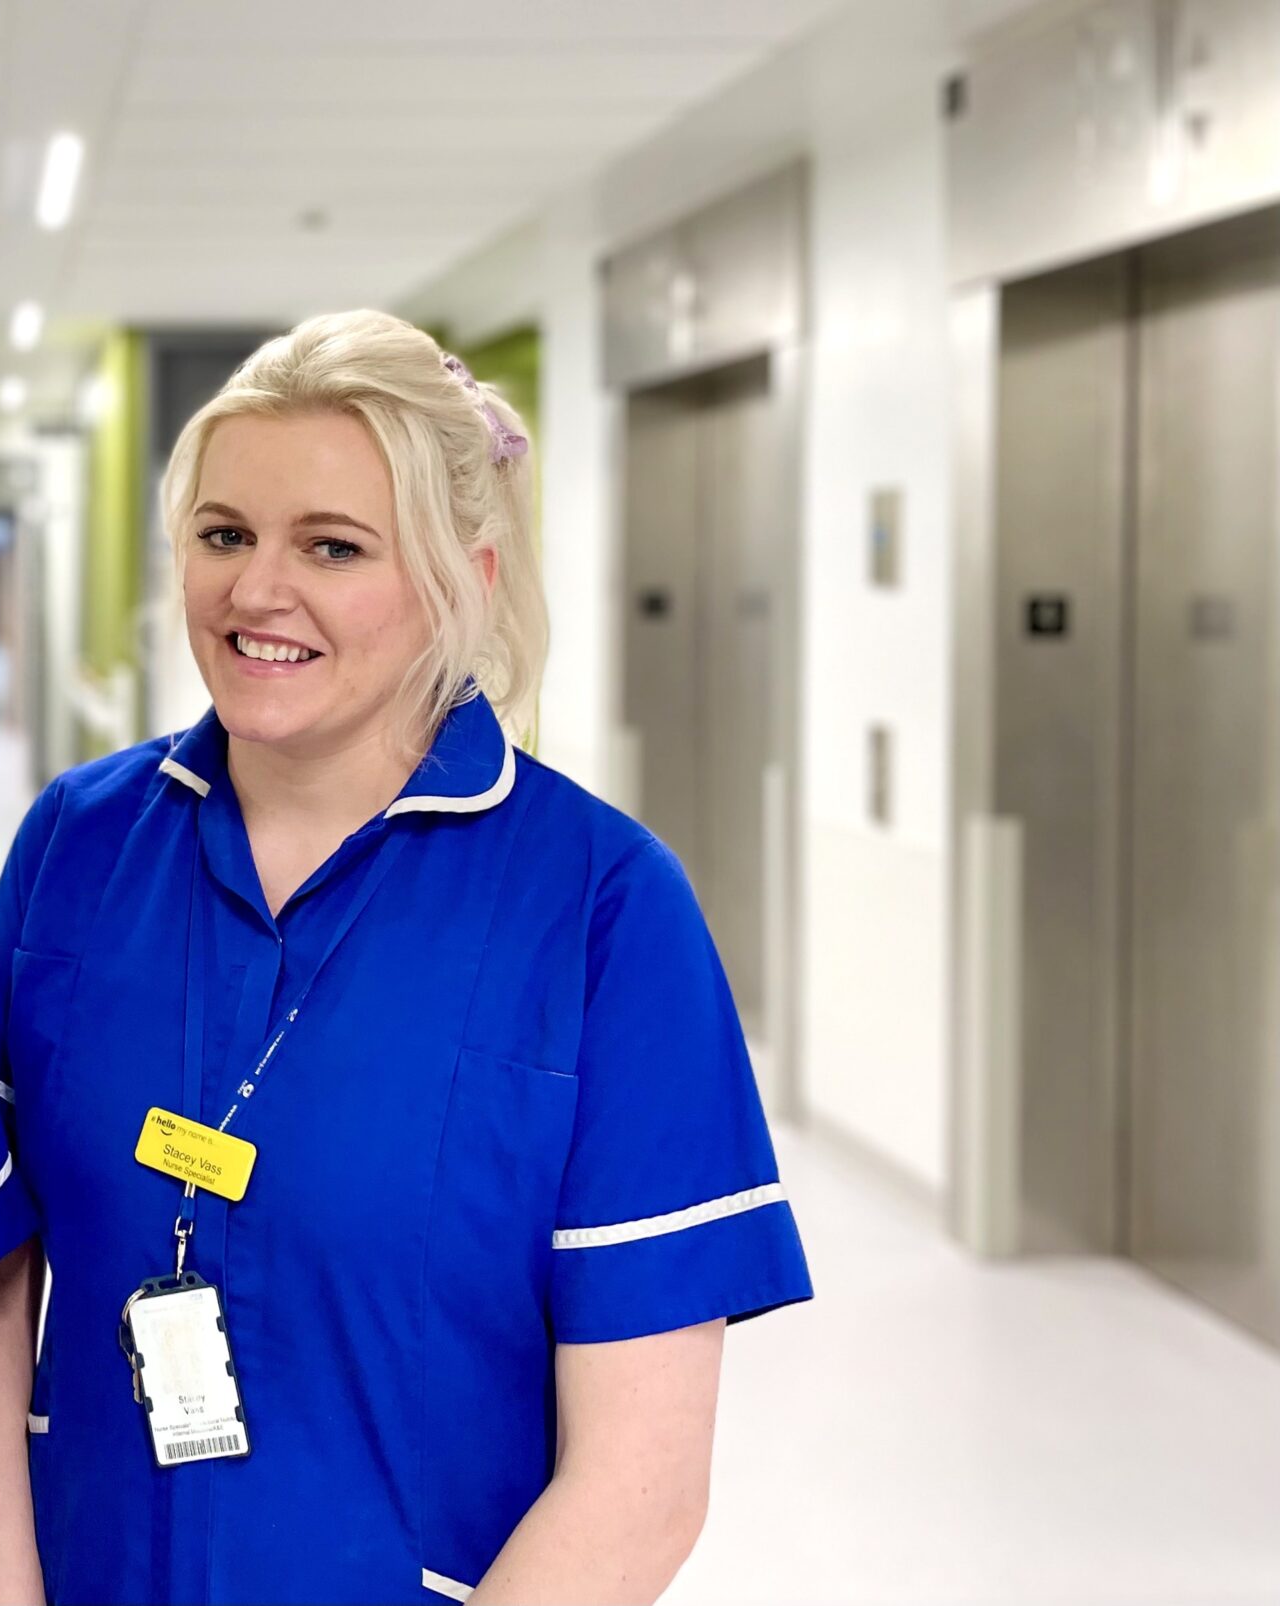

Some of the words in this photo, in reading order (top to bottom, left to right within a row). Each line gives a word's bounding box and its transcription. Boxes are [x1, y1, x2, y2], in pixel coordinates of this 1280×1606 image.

[162, 1158, 183, 1172] Nurse
[183, 1167, 216, 1185] Specialist
[163, 1143, 197, 1166] Stacey
[199, 1157, 222, 1176] Vass
